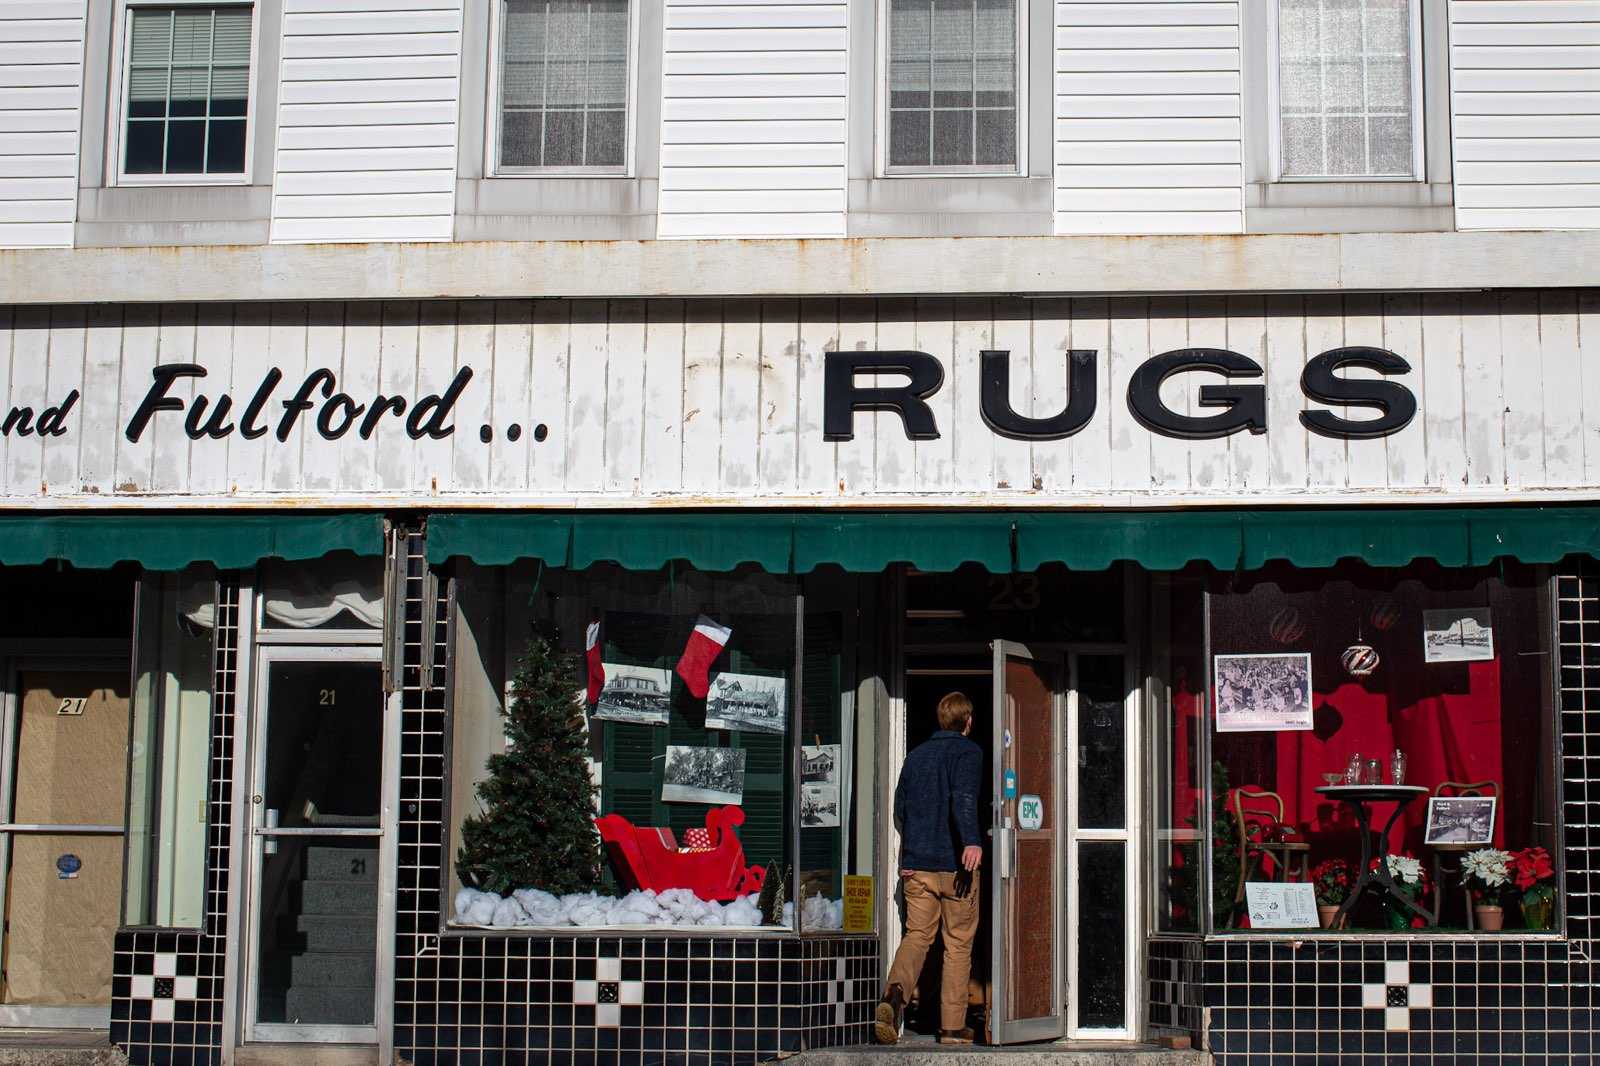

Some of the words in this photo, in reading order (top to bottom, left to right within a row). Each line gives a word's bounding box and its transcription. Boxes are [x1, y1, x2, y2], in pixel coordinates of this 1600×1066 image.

[823, 346, 1417, 442] RUGS
[0, 389, 80, 437] nd
[988, 574, 1041, 609] 23
[60, 699, 82, 712] 21
[320, 689, 336, 705] 21
[351, 859, 366, 874] 21
